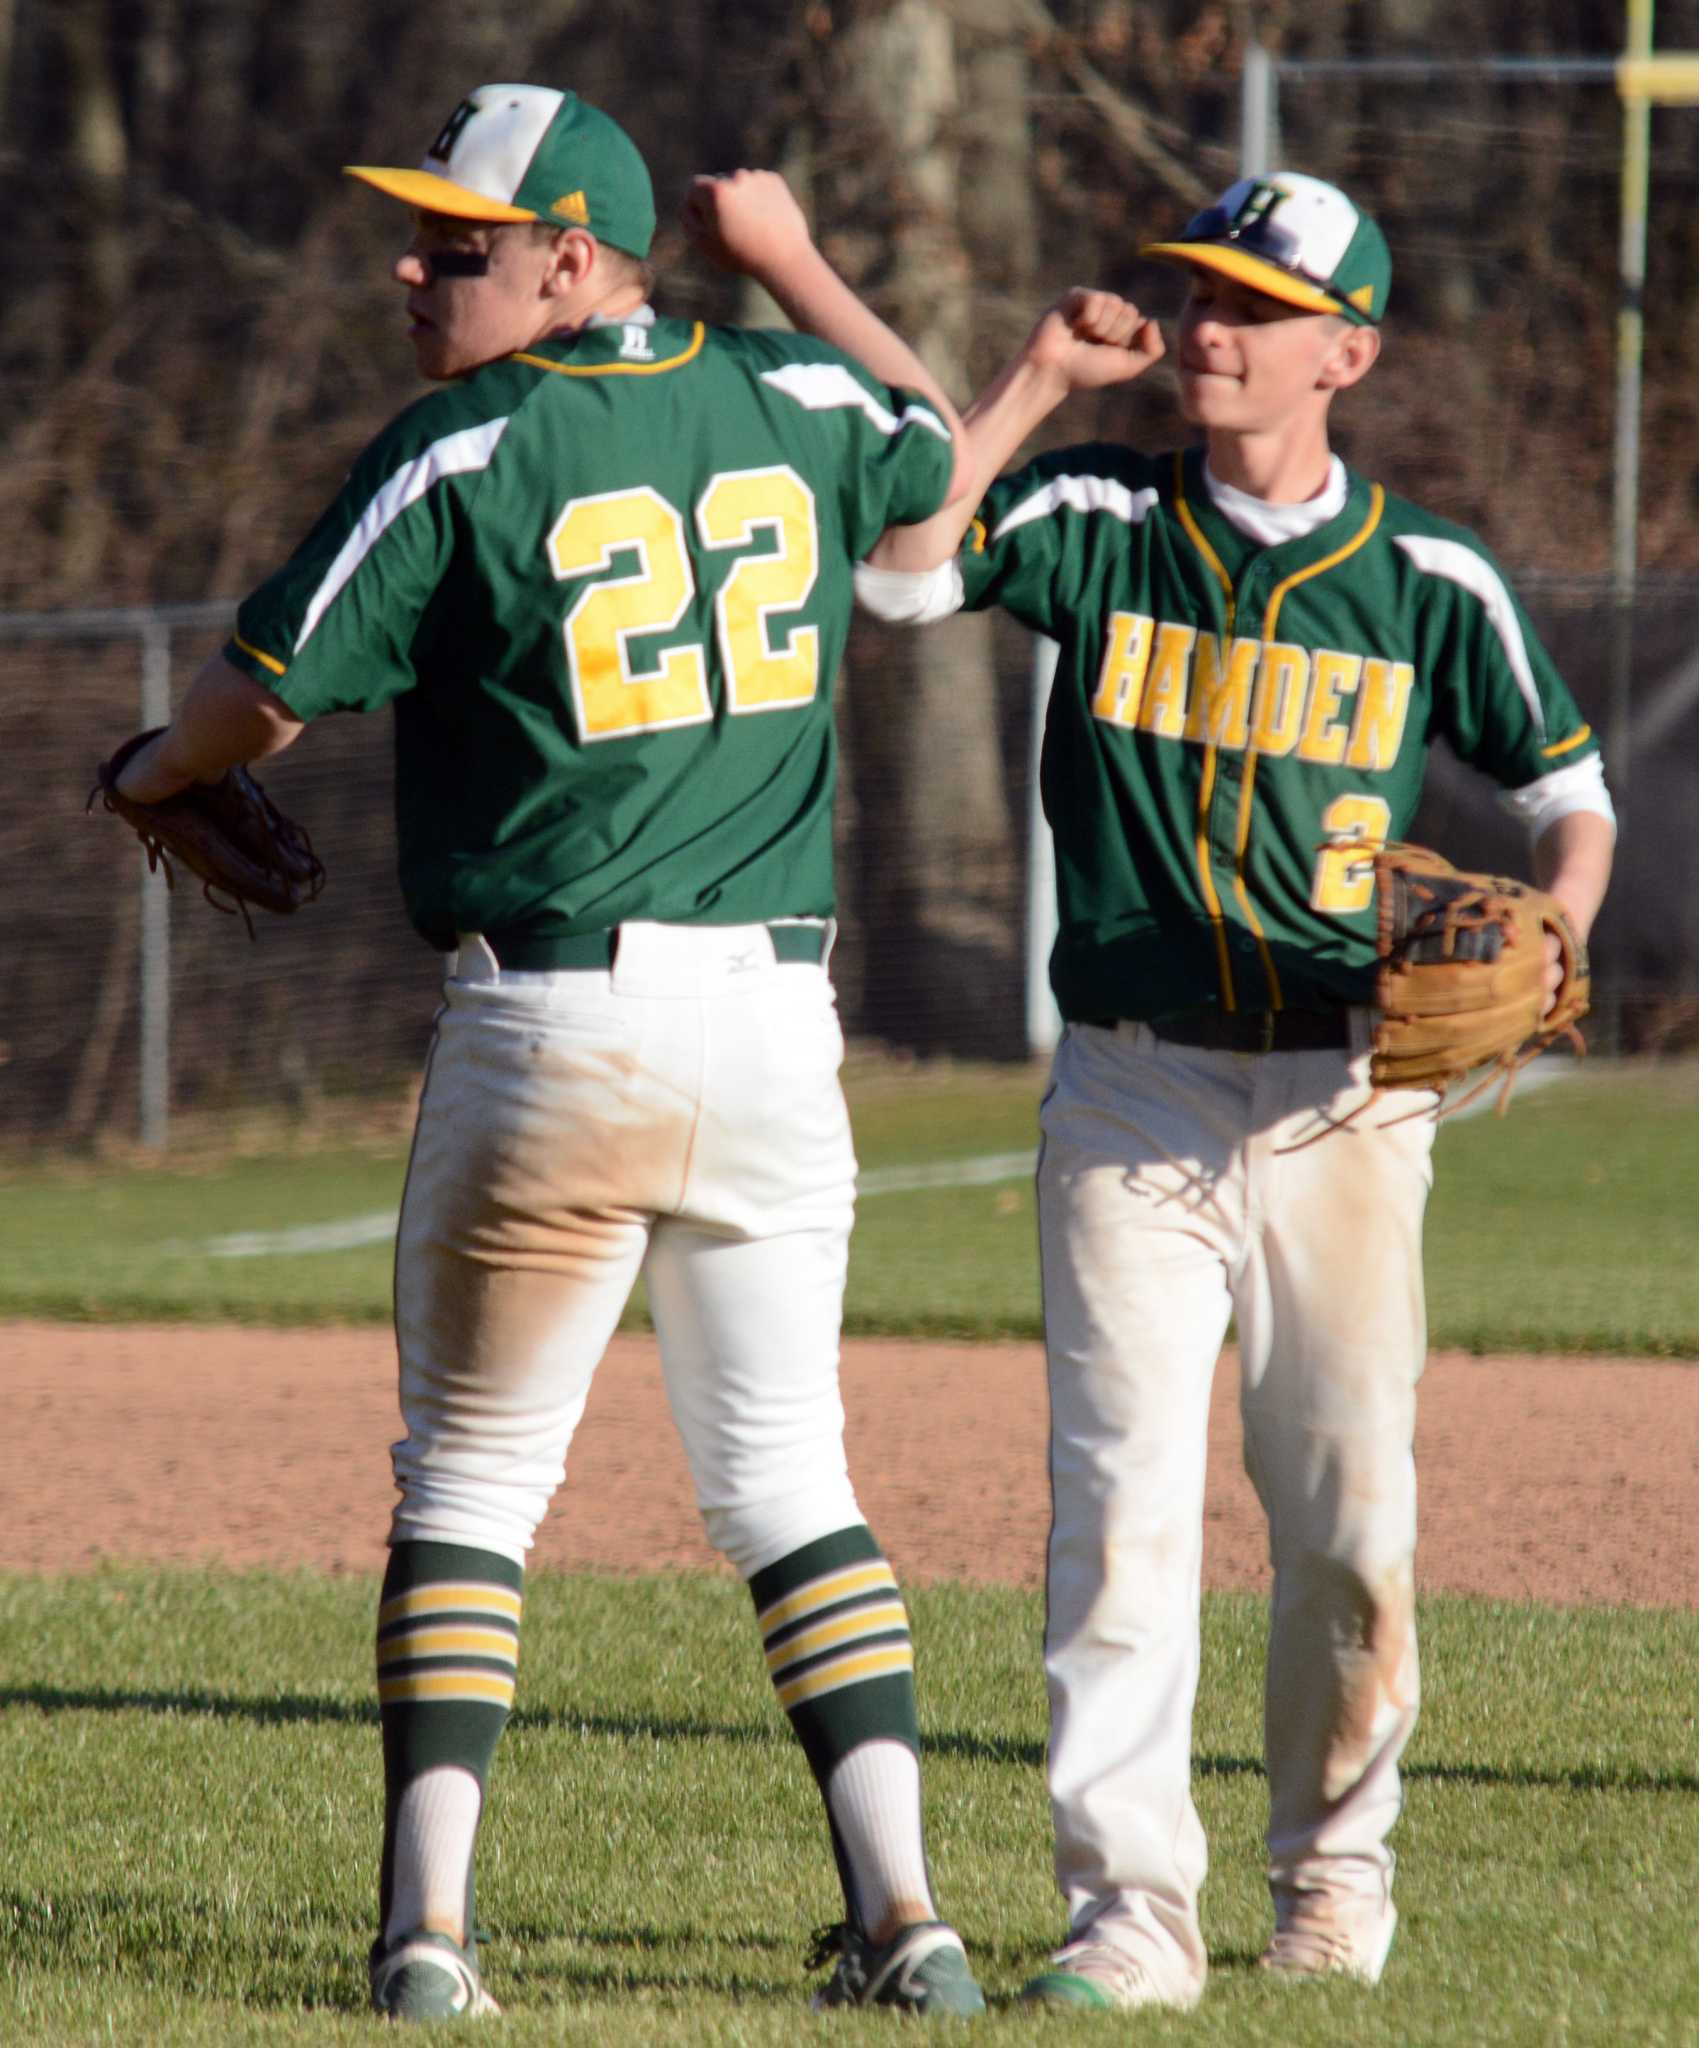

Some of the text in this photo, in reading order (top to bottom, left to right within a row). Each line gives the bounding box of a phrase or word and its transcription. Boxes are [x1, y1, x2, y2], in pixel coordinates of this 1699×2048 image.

[546, 464, 818, 744] 22
[1093, 610, 1415, 772] HAMDEN
[1310, 793, 1391, 913] 2
